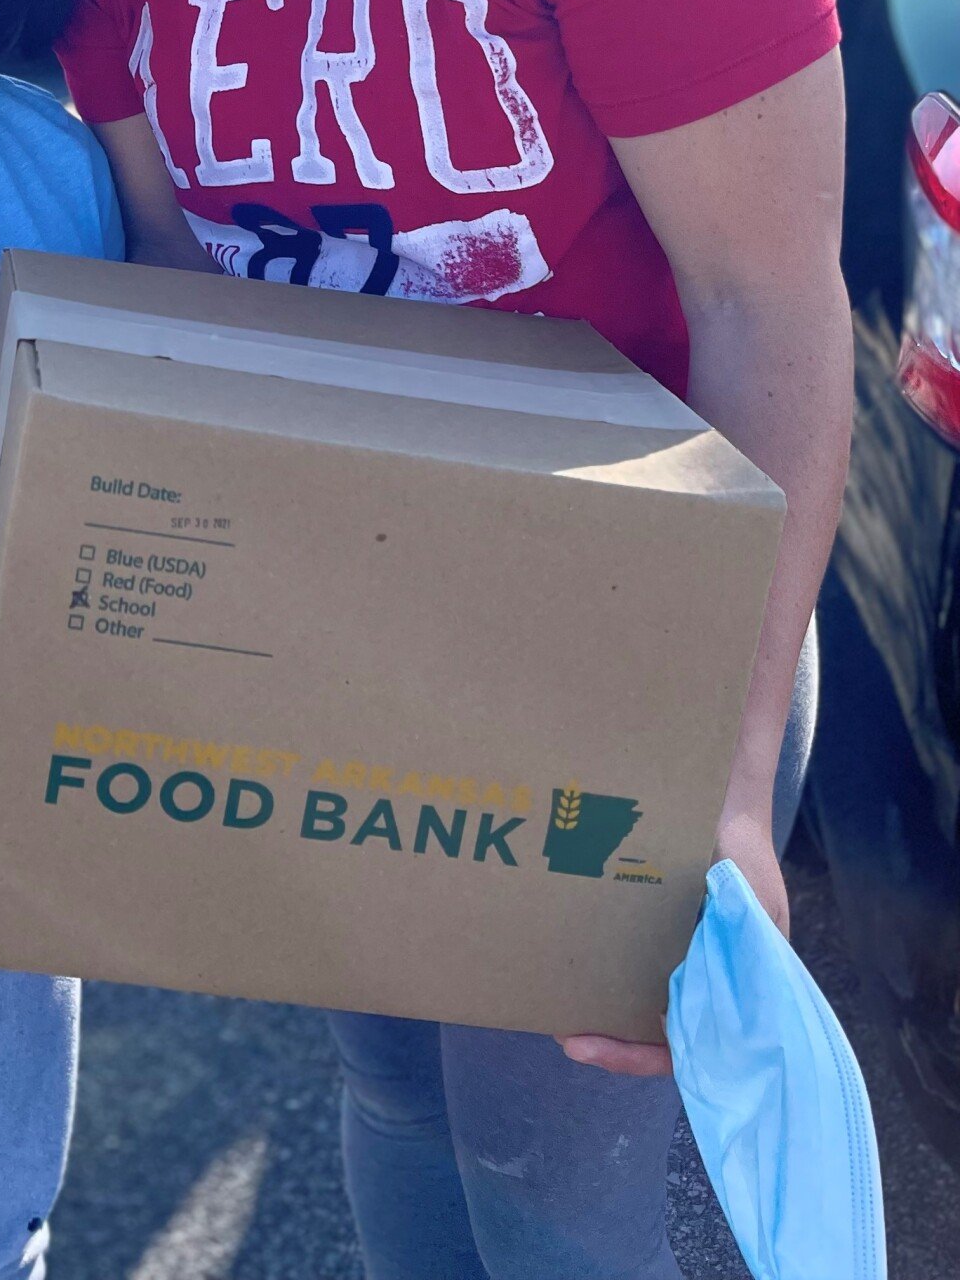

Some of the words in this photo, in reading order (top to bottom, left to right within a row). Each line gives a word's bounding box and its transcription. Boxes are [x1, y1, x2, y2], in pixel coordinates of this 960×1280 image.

[90, 475, 134, 496] Build
[137, 482, 182, 504] Date:
[170, 517, 191, 529] SEP
[106, 548, 143, 568] Blue
[147, 554, 206, 579] (USDA)
[102, 571, 135, 592] Red
[139, 576, 193, 601] (Food)
[98, 594, 156, 618] School
[95, 617, 145, 638] Other
[52, 722, 302, 777] NORTHWEST
[311, 758, 534, 812] ARKANSAS
[44, 754, 275, 829] FOOD
[299, 790, 528, 868] BANK
[613, 871, 663, 885] AMERICA
